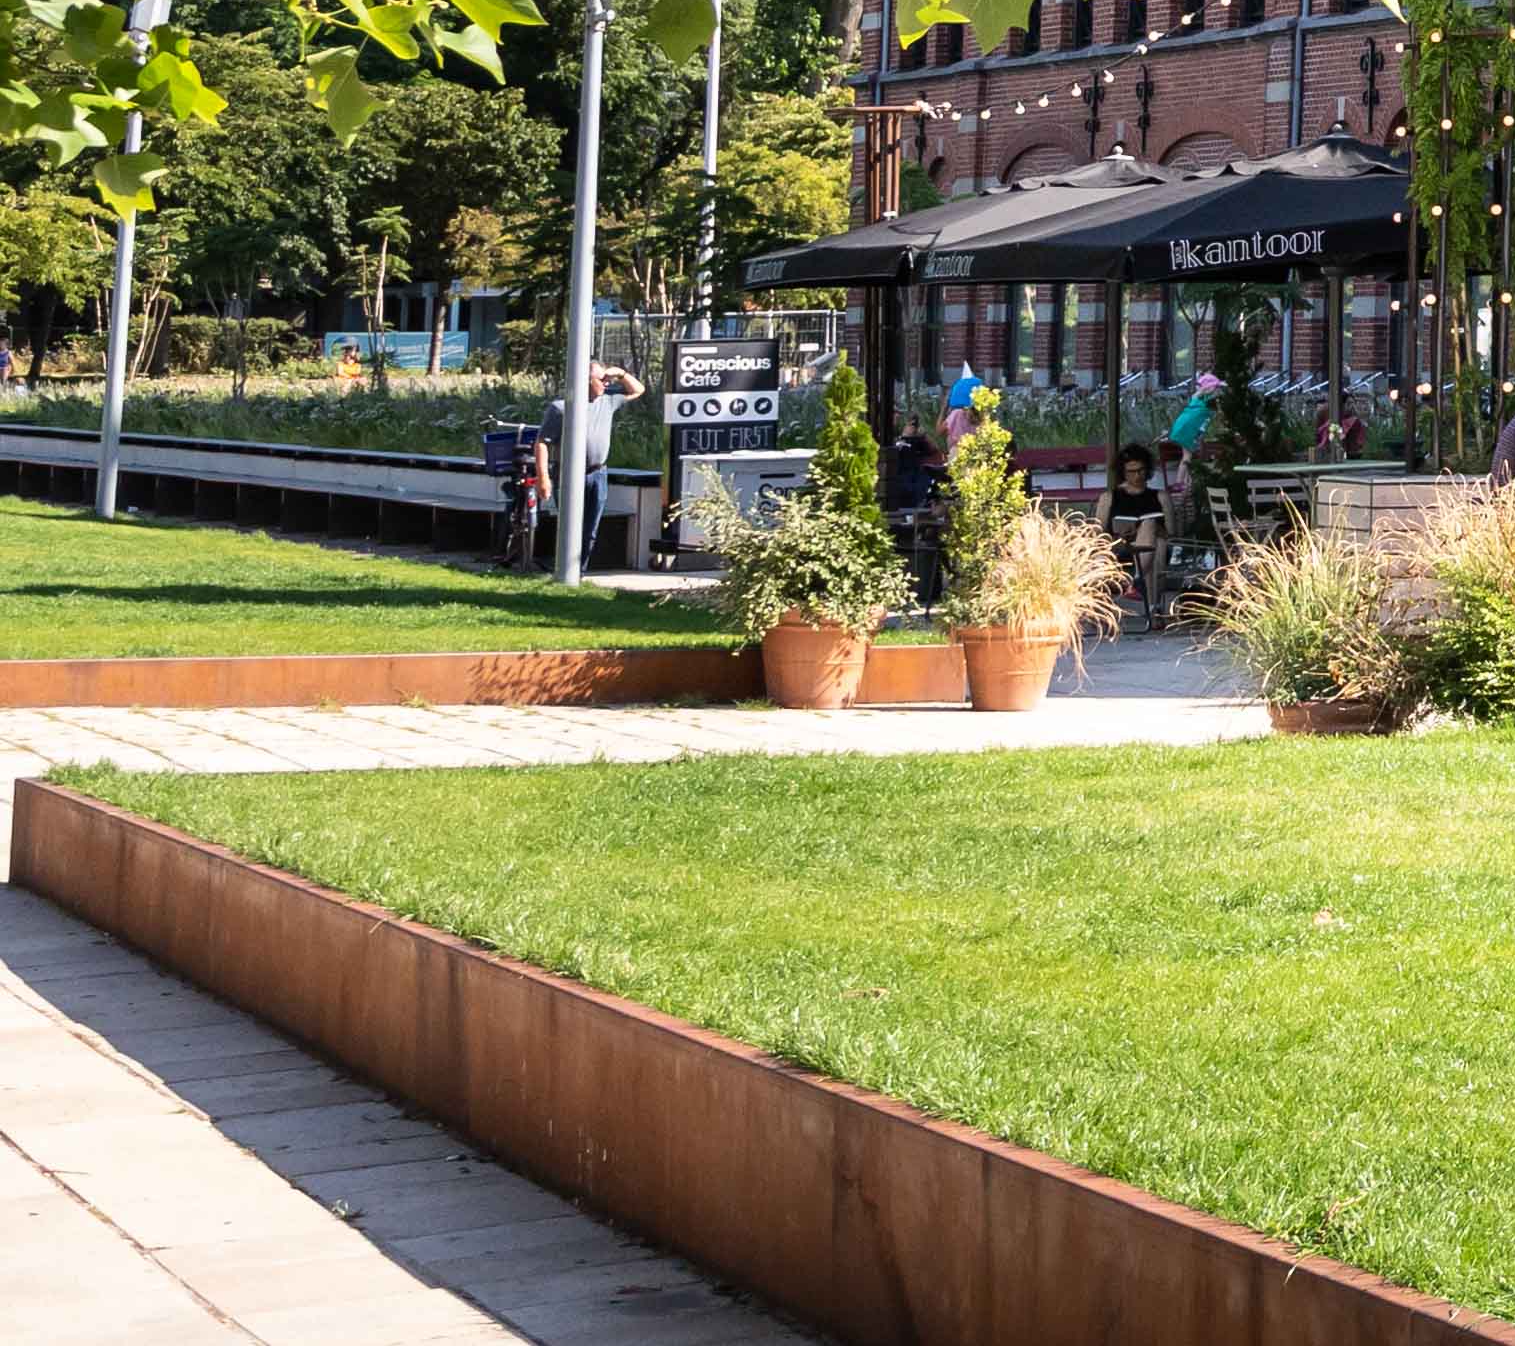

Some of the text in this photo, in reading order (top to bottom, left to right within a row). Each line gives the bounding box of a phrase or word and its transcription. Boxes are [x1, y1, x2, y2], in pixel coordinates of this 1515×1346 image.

[1185, 230, 1325, 268] kantoor
[680, 355, 772, 371] Conscious
[680, 370, 722, 388] Café
